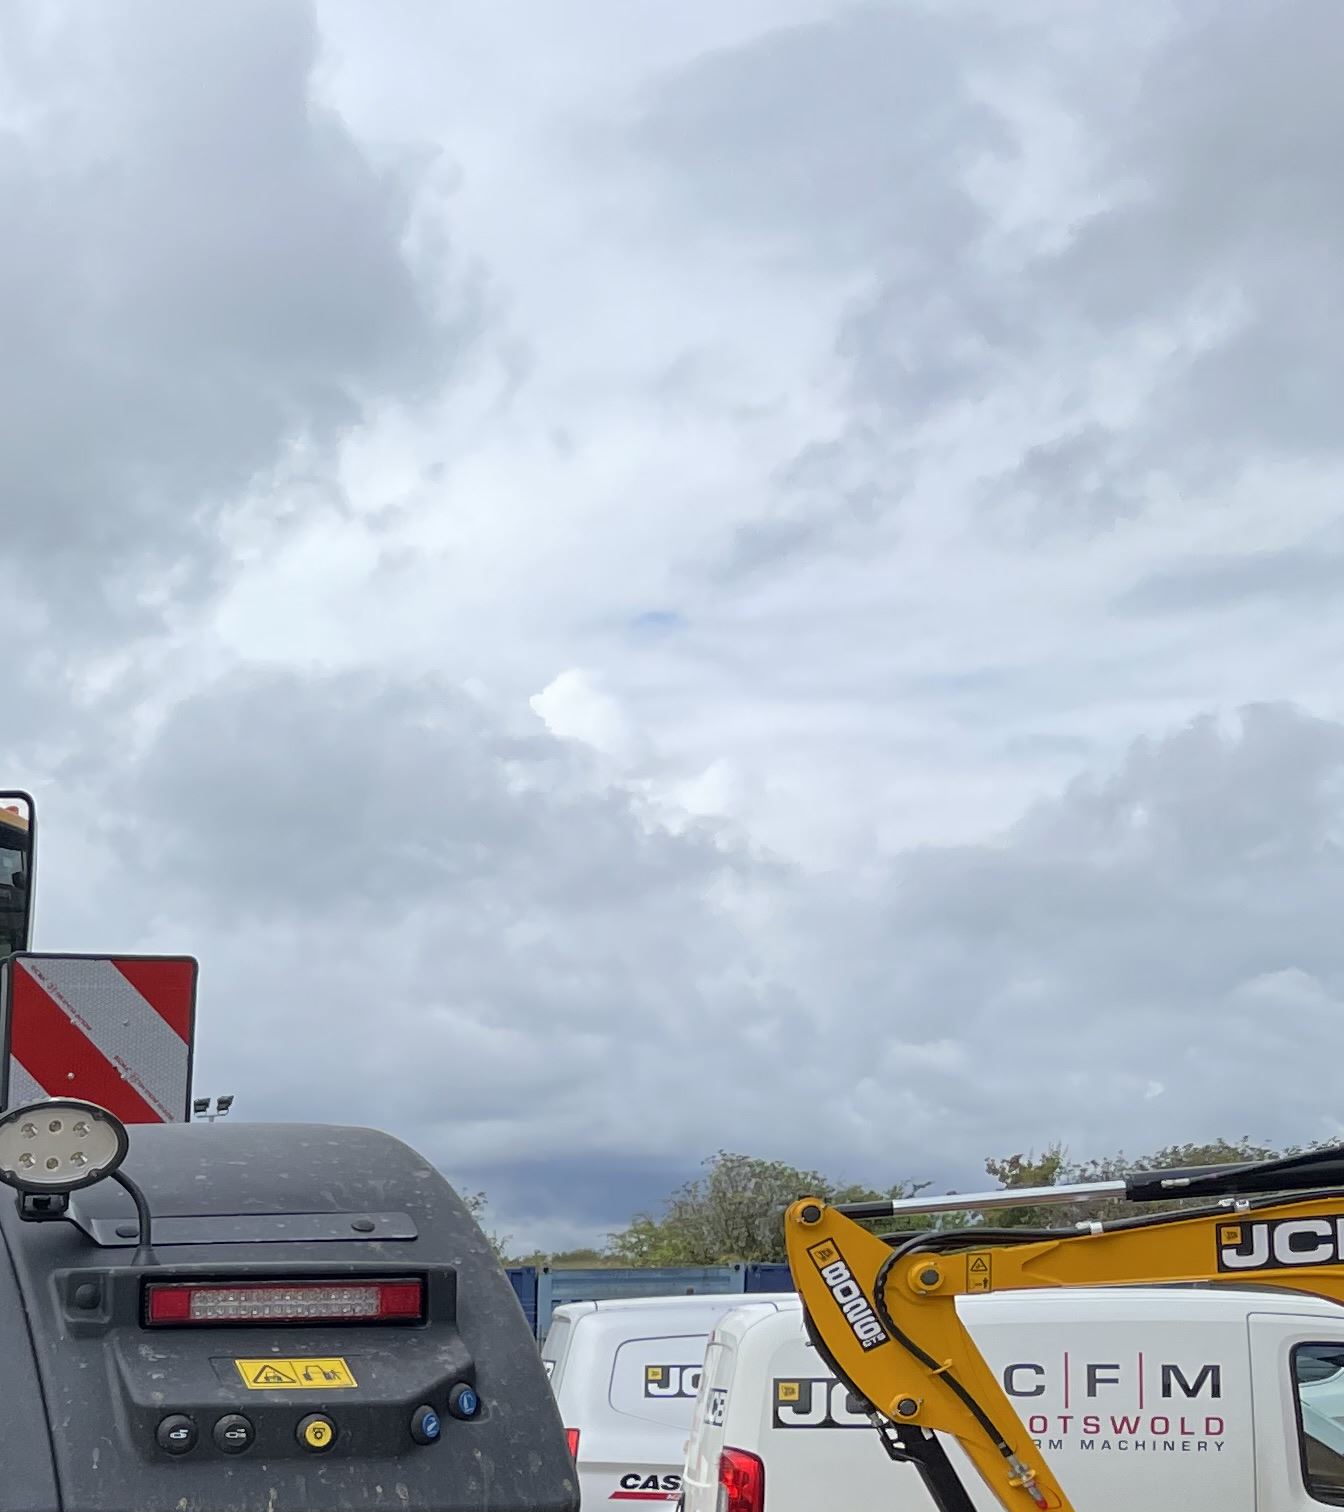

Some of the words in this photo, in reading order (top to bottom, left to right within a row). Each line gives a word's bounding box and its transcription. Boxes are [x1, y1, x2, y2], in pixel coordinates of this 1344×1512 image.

[1221, 1217, 1344, 1268] JC
[821, 1259, 882, 1341] 8026
[647, 1367, 704, 1396] JC
[777, 1381, 885, 1425] JC
[1028, 1415, 1225, 1436] OTSWOLD
[1035, 1439, 1063, 1451] RM
[1080, 1439, 1225, 1452] MACHINERY
[619, 1473, 682, 1491] CAS
